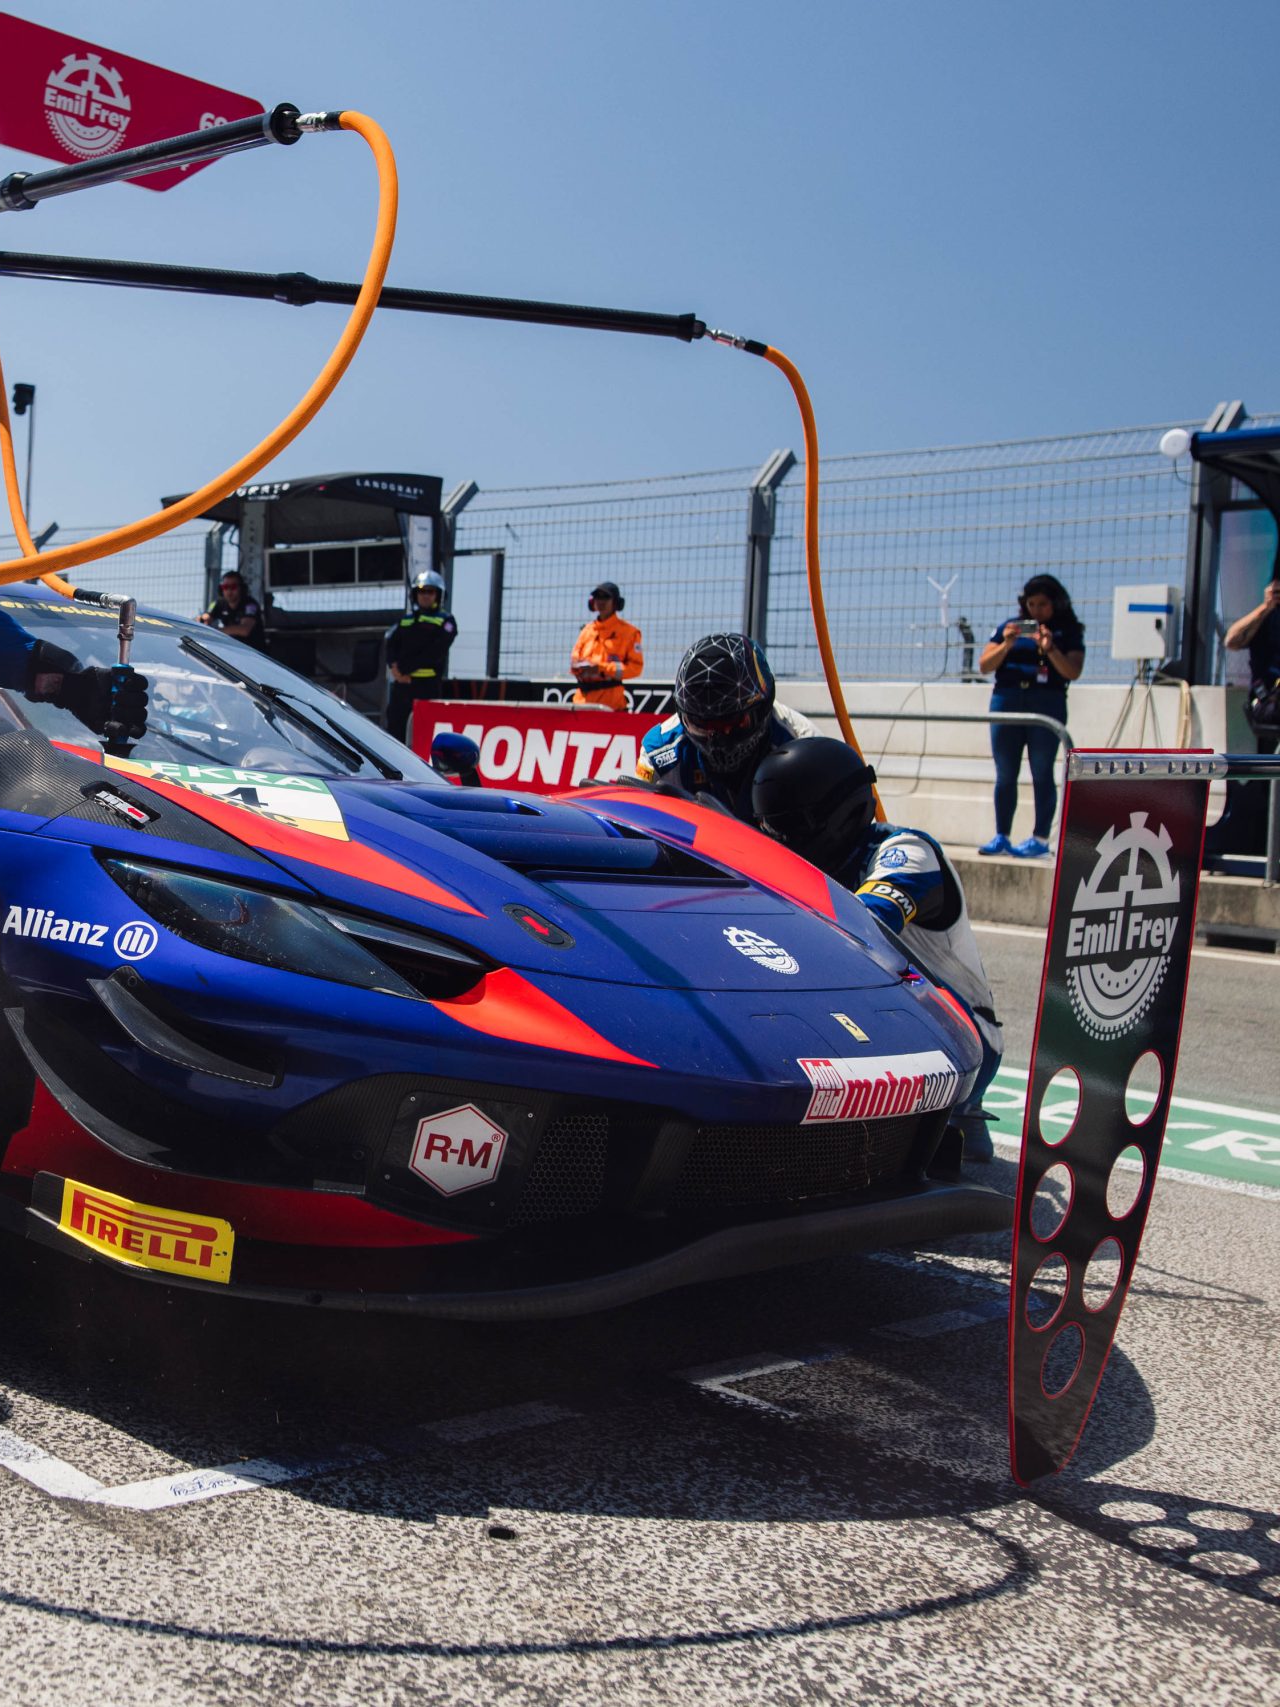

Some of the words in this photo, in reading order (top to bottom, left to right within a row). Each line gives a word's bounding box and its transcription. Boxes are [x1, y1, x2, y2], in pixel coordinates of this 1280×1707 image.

[44, 87, 87, 117] Emil
[89, 101, 131, 133] Frey
[873, 885, 913, 915] DTM
[2, 905, 109, 947] Allianz
[1065, 910, 1124, 957] Emil
[1125, 912, 1179, 954] Frey
[806, 1062, 842, 1089] Auto
[811, 1089, 840, 1118] Bild
[70, 1190, 218, 1267] PIRELLI
